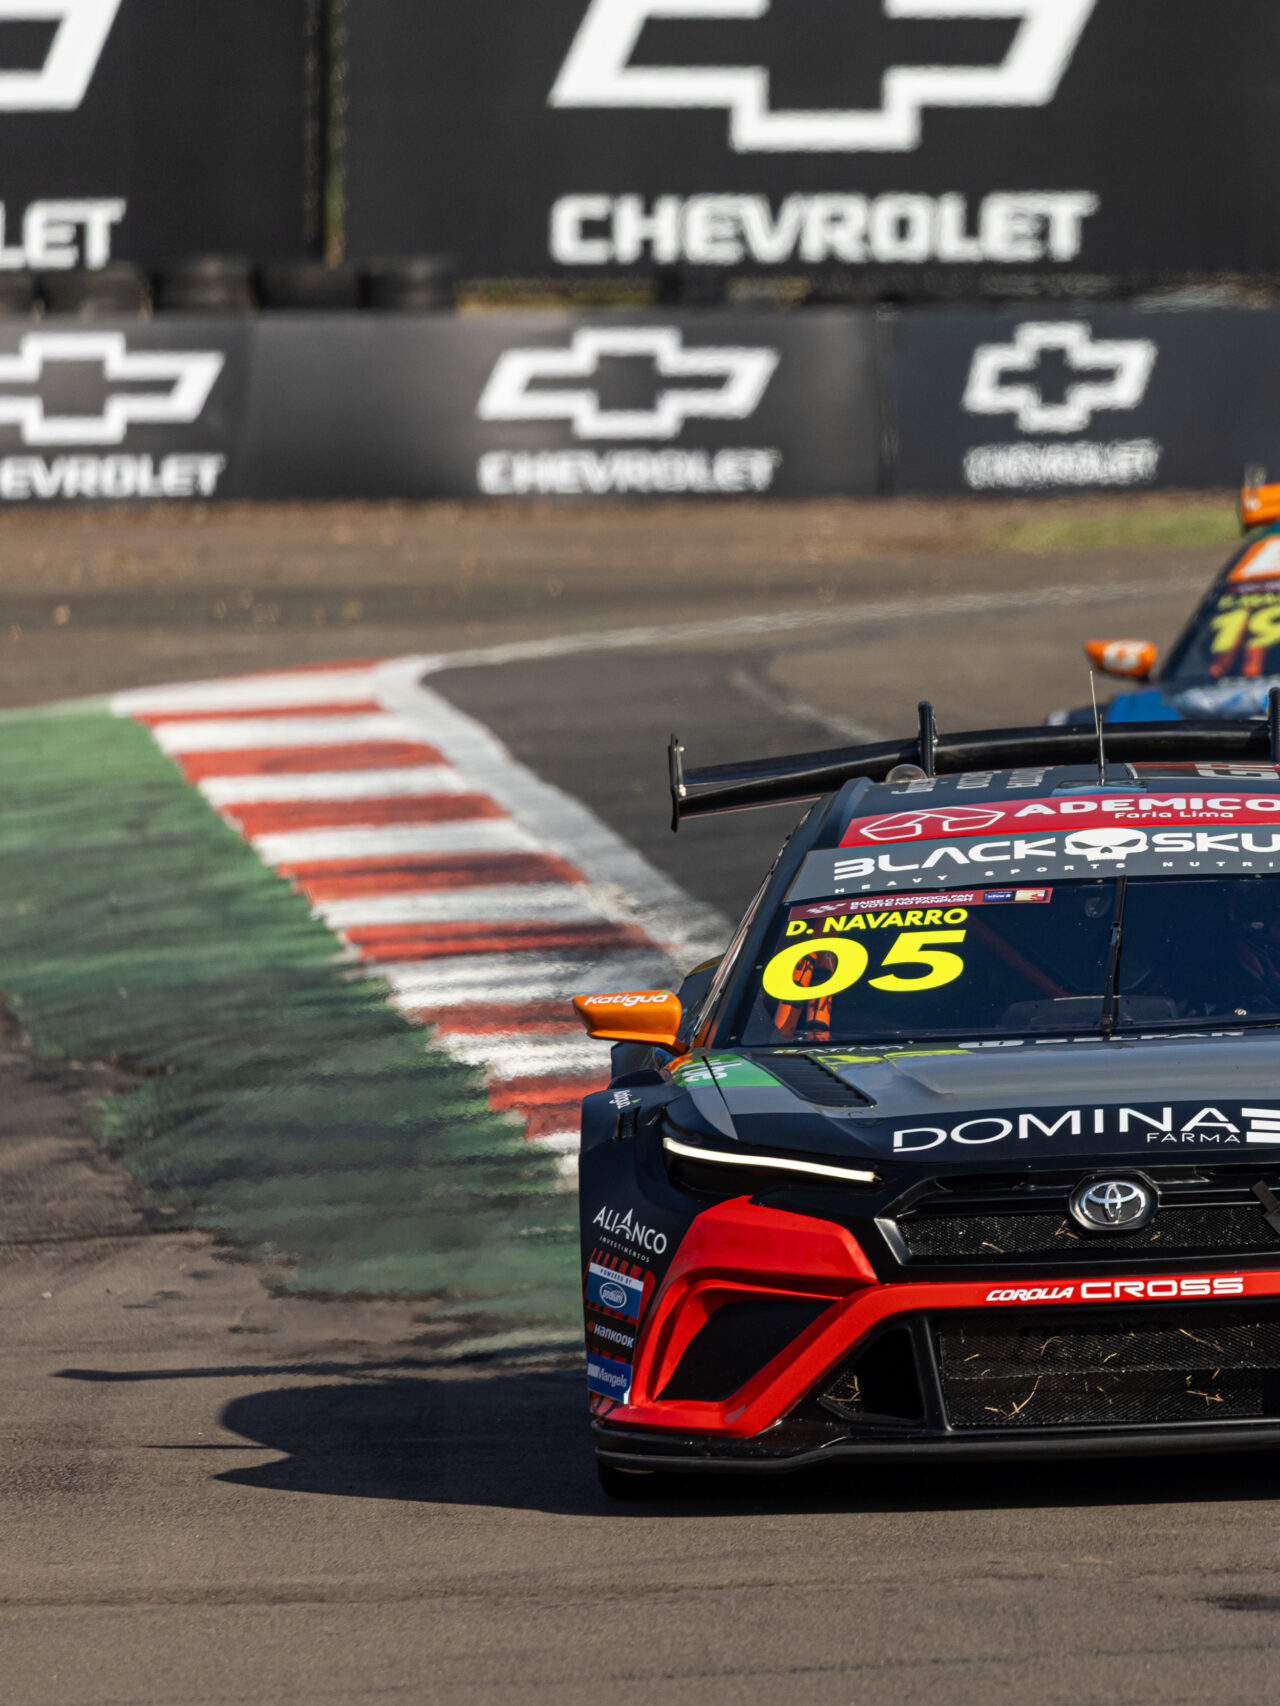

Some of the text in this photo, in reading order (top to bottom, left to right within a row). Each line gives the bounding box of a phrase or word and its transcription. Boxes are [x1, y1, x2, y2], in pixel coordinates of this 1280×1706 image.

[551, 194, 1098, 264] CHEVROLET
[477, 449, 778, 494] CHEVROLET
[1115, 811, 1169, 819] Faria
[834, 837, 1056, 881] BLACK
[834, 875, 948, 894] HEAVY
[984, 862, 1126, 877] SPORTS
[785, 908, 969, 936] D. NAVARRO
[762, 929, 967, 1001] 05
[893, 1107, 1241, 1153] DOMINA
[1147, 1132, 1241, 1144] FARMA
[592, 1205, 668, 1254] ALIANCO
[599, 1235, 650, 1263] INVESTIMENTOS
[600, 1267, 633, 1286] POWERED BY
[986, 1277, 1244, 1302] COROLLA CROSS
